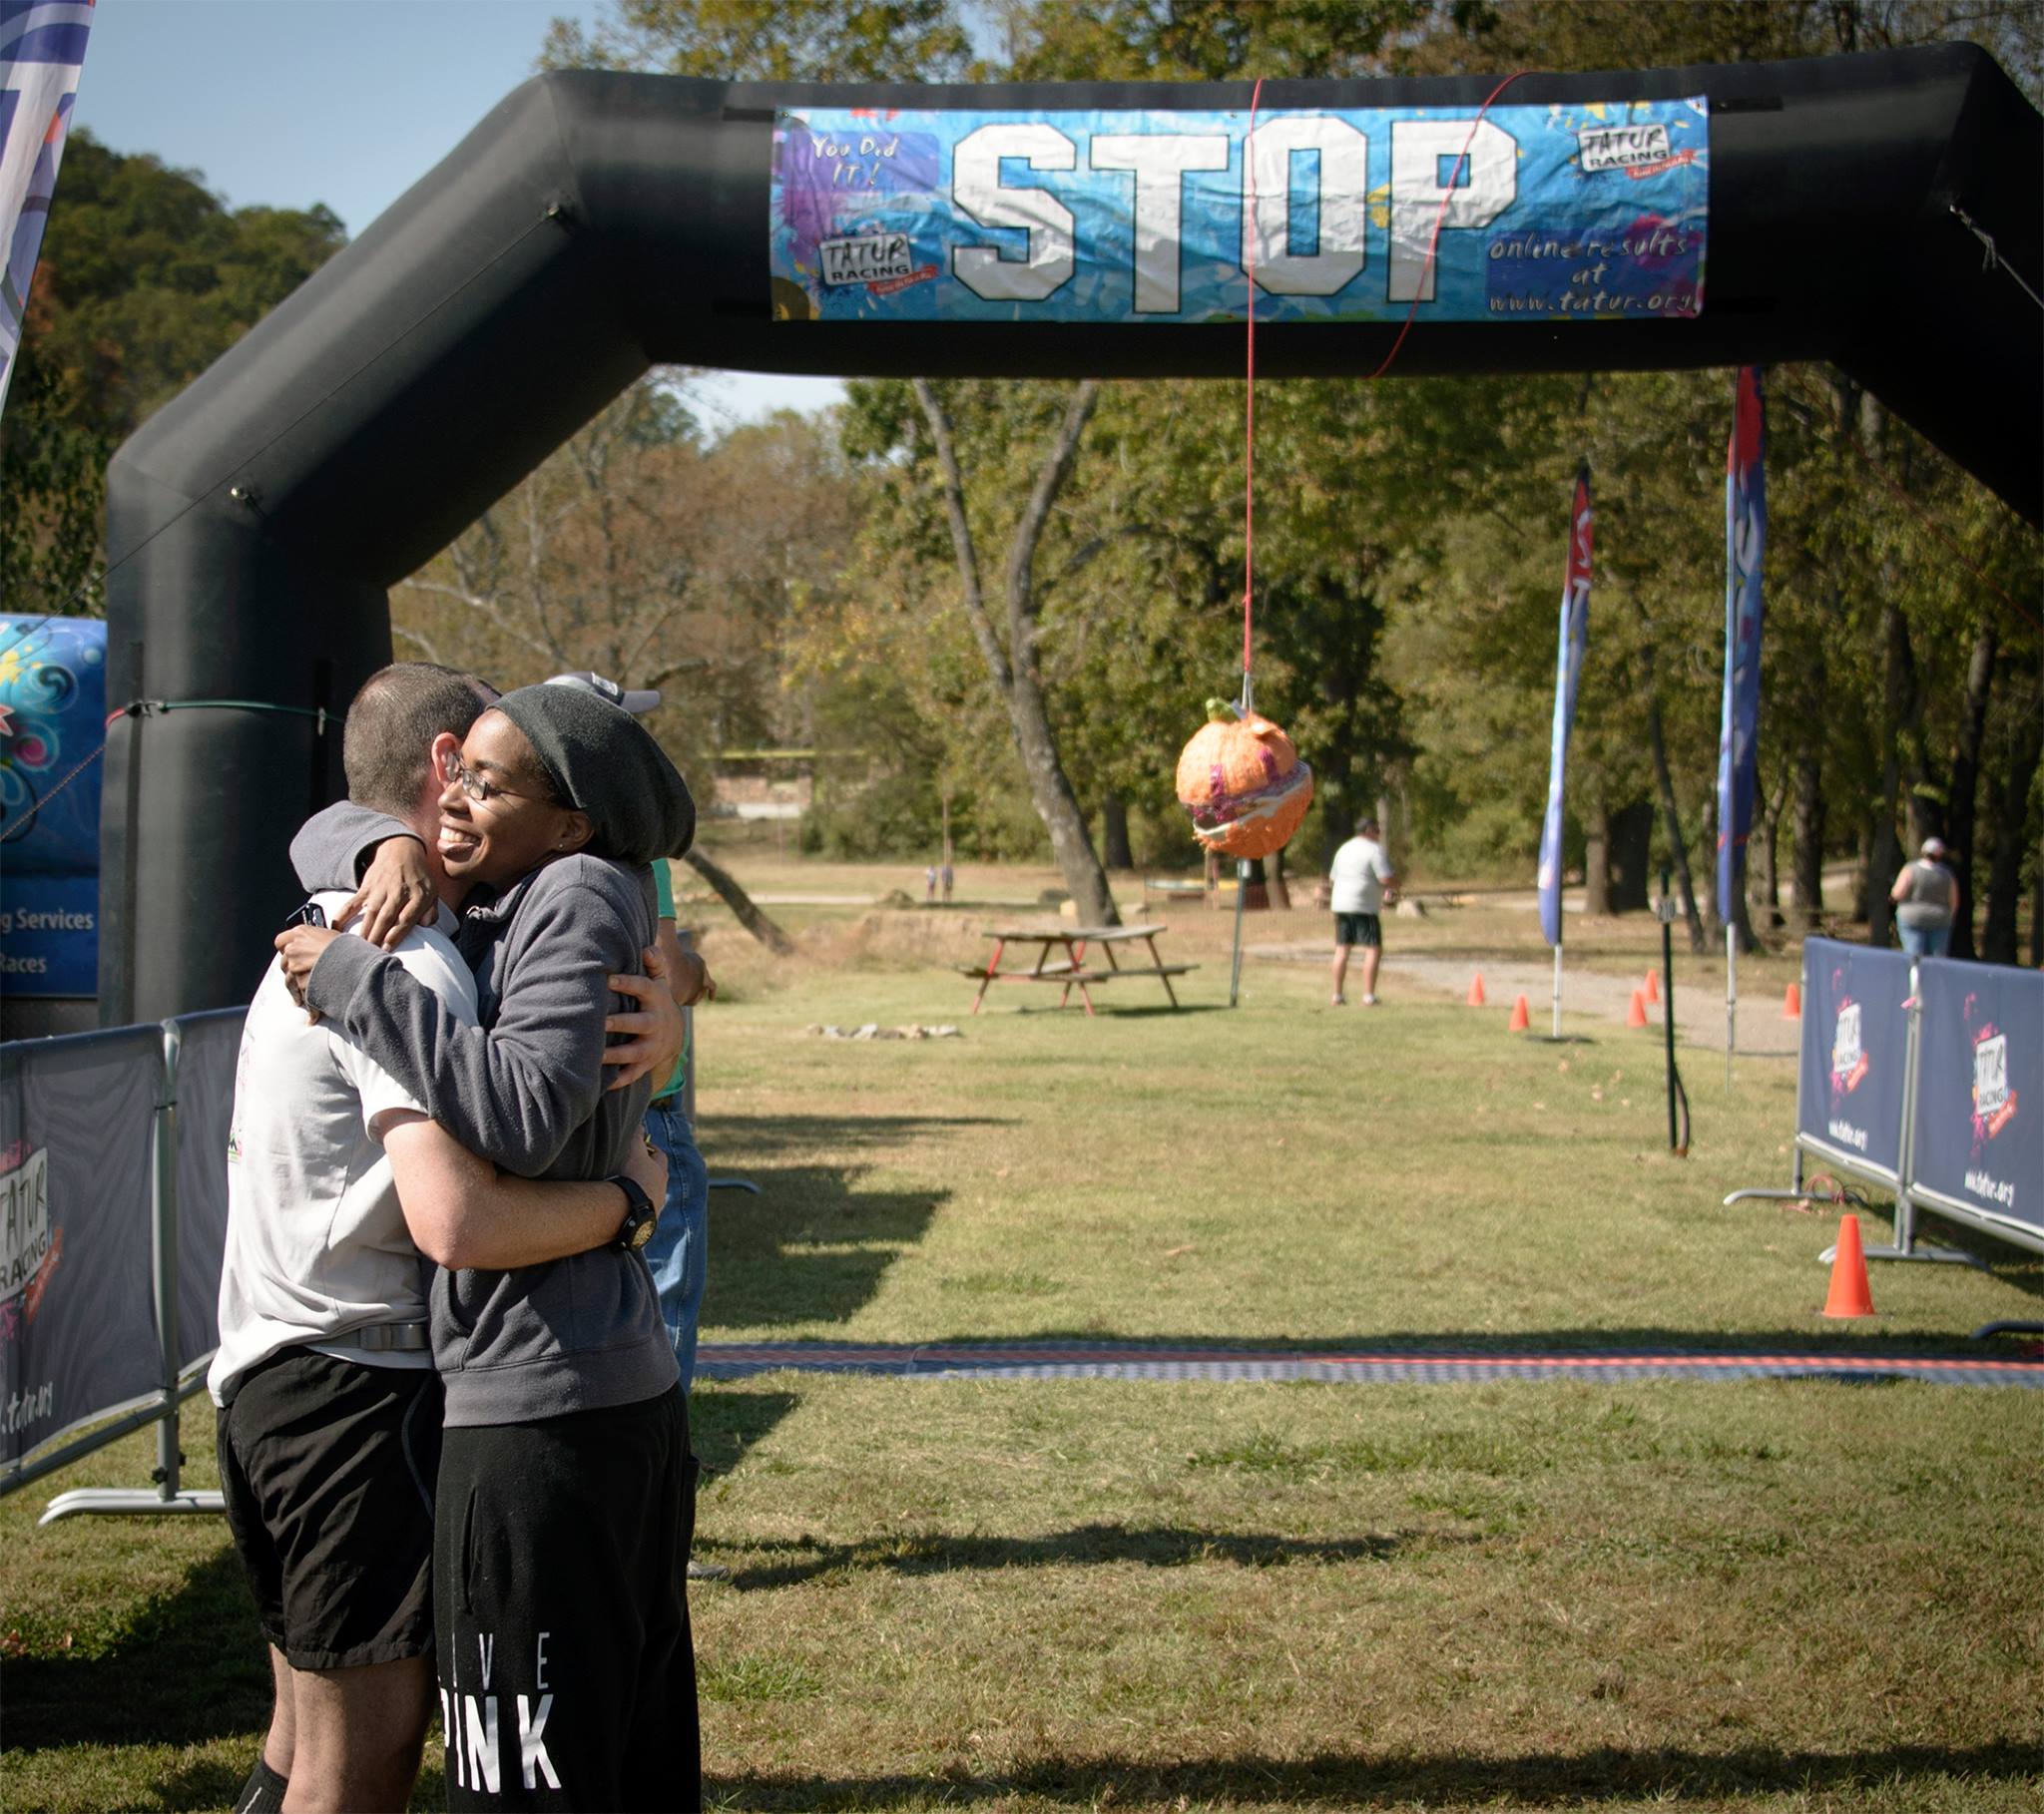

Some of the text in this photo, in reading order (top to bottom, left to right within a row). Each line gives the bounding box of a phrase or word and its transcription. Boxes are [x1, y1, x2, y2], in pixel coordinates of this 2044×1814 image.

[809, 134, 898, 160] You Did
[1590, 150, 1668, 168] RACING
[952, 117, 1517, 314] STOP
[824, 237, 907, 267] TATUR
[1489, 231, 1575, 259] online
[831, 264, 910, 281] RACING
[1572, 262, 1608, 284] at
[16, 907, 94, 930] Services
